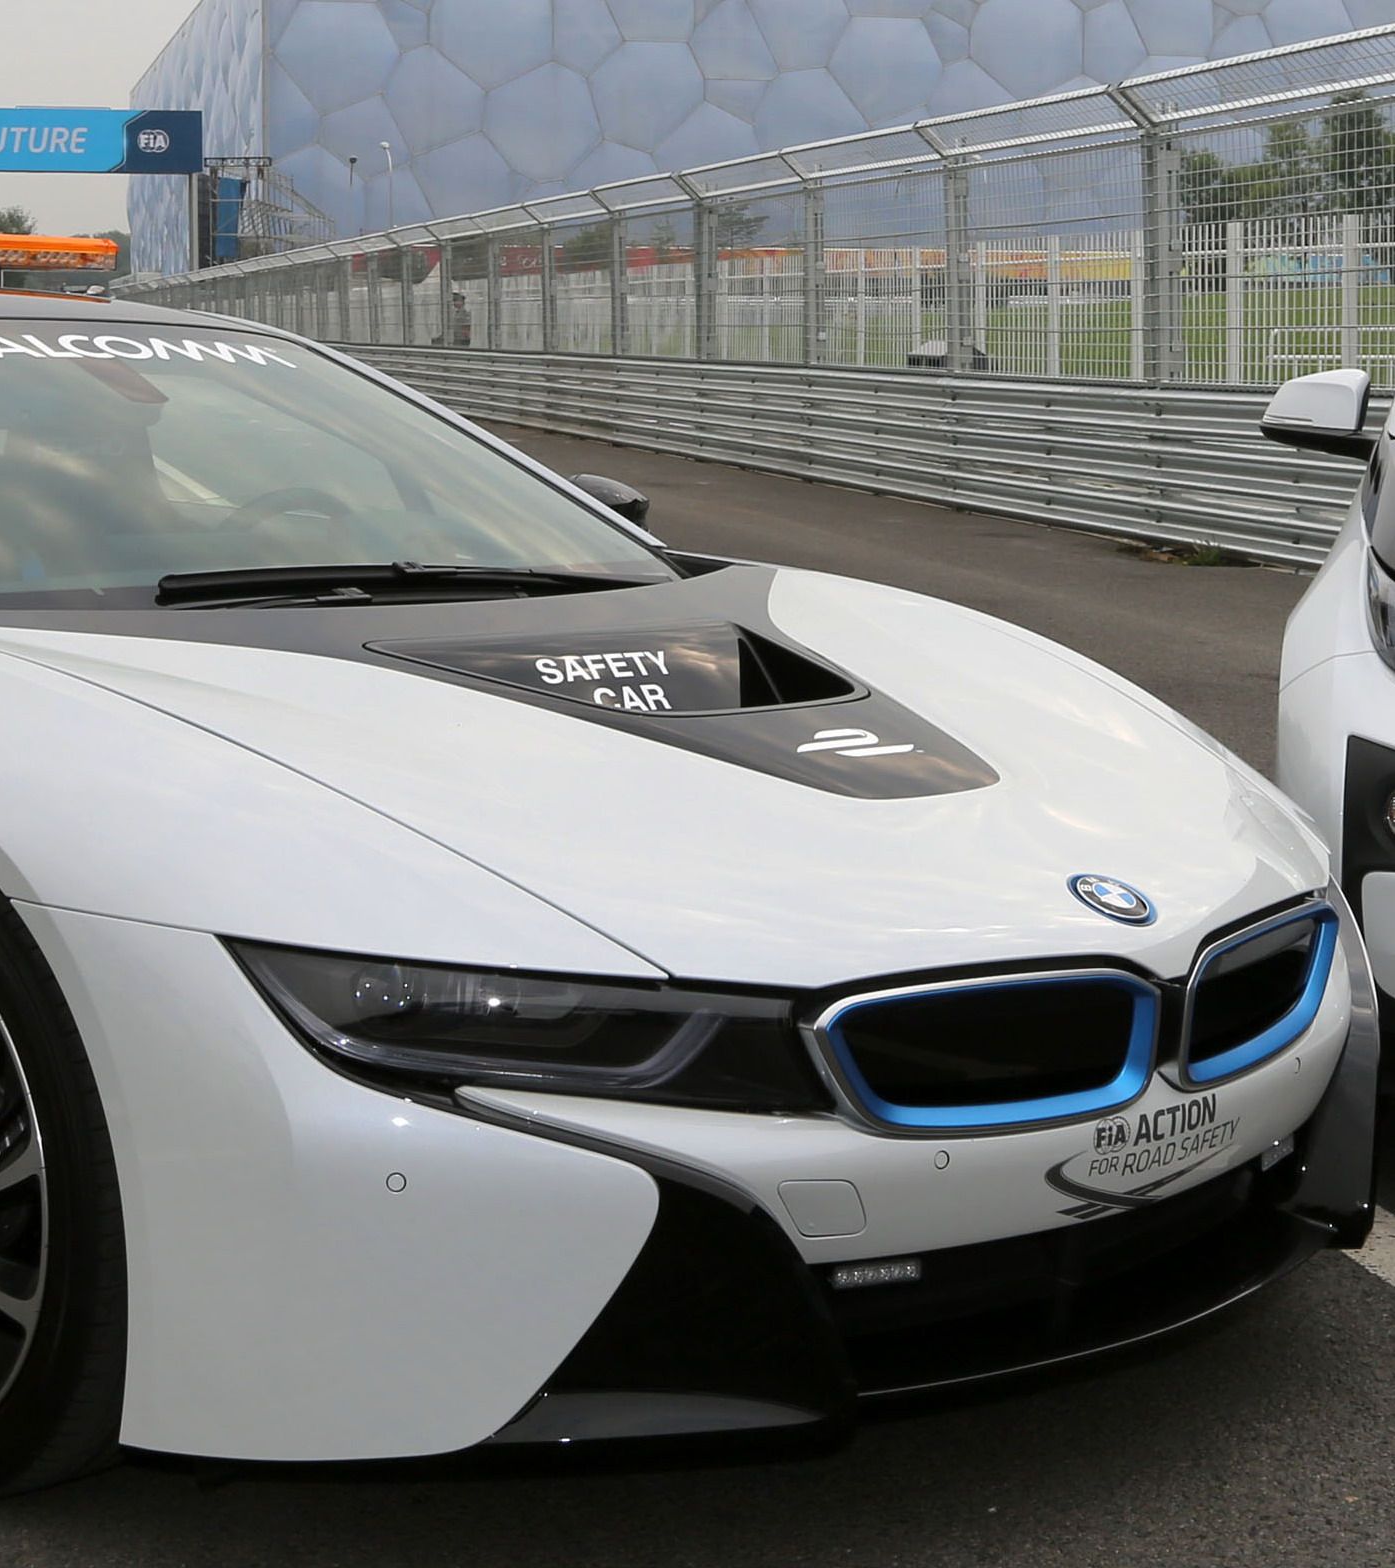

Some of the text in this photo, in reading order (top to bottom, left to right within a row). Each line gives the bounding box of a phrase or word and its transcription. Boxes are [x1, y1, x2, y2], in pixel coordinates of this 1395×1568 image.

[535, 651, 669, 684] SAFETY
[593, 684, 672, 711] CAR
[1134, 1093, 1217, 1147] ACTION
[1088, 1117, 1241, 1176] FOR ROAD SAFETY
